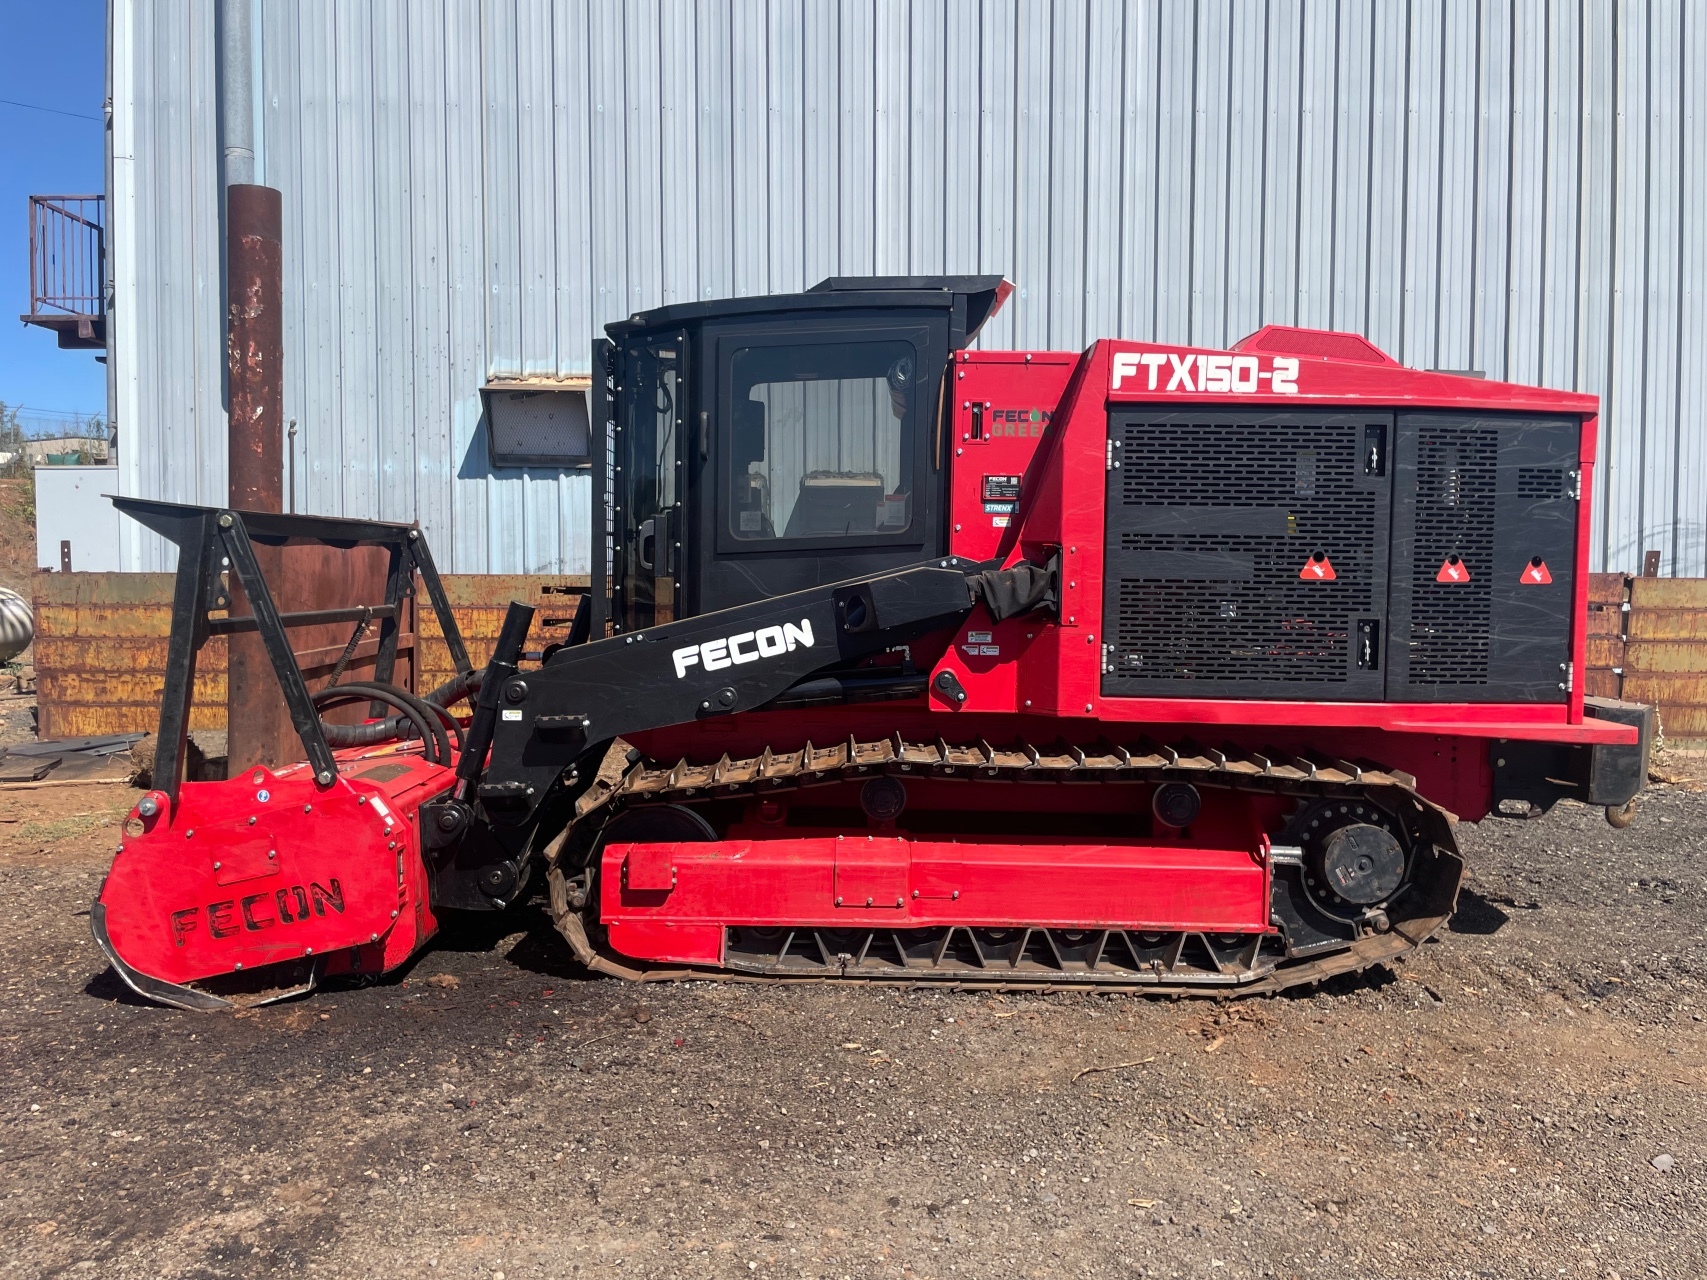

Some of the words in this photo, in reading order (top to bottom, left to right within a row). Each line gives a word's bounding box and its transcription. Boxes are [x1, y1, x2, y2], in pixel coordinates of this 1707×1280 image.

[1112, 352, 1299, 393] FTX150-2
[985, 503, 1014, 512] STRENX
[672, 618, 815, 679] FECON
[170, 878, 346, 947] FECON
